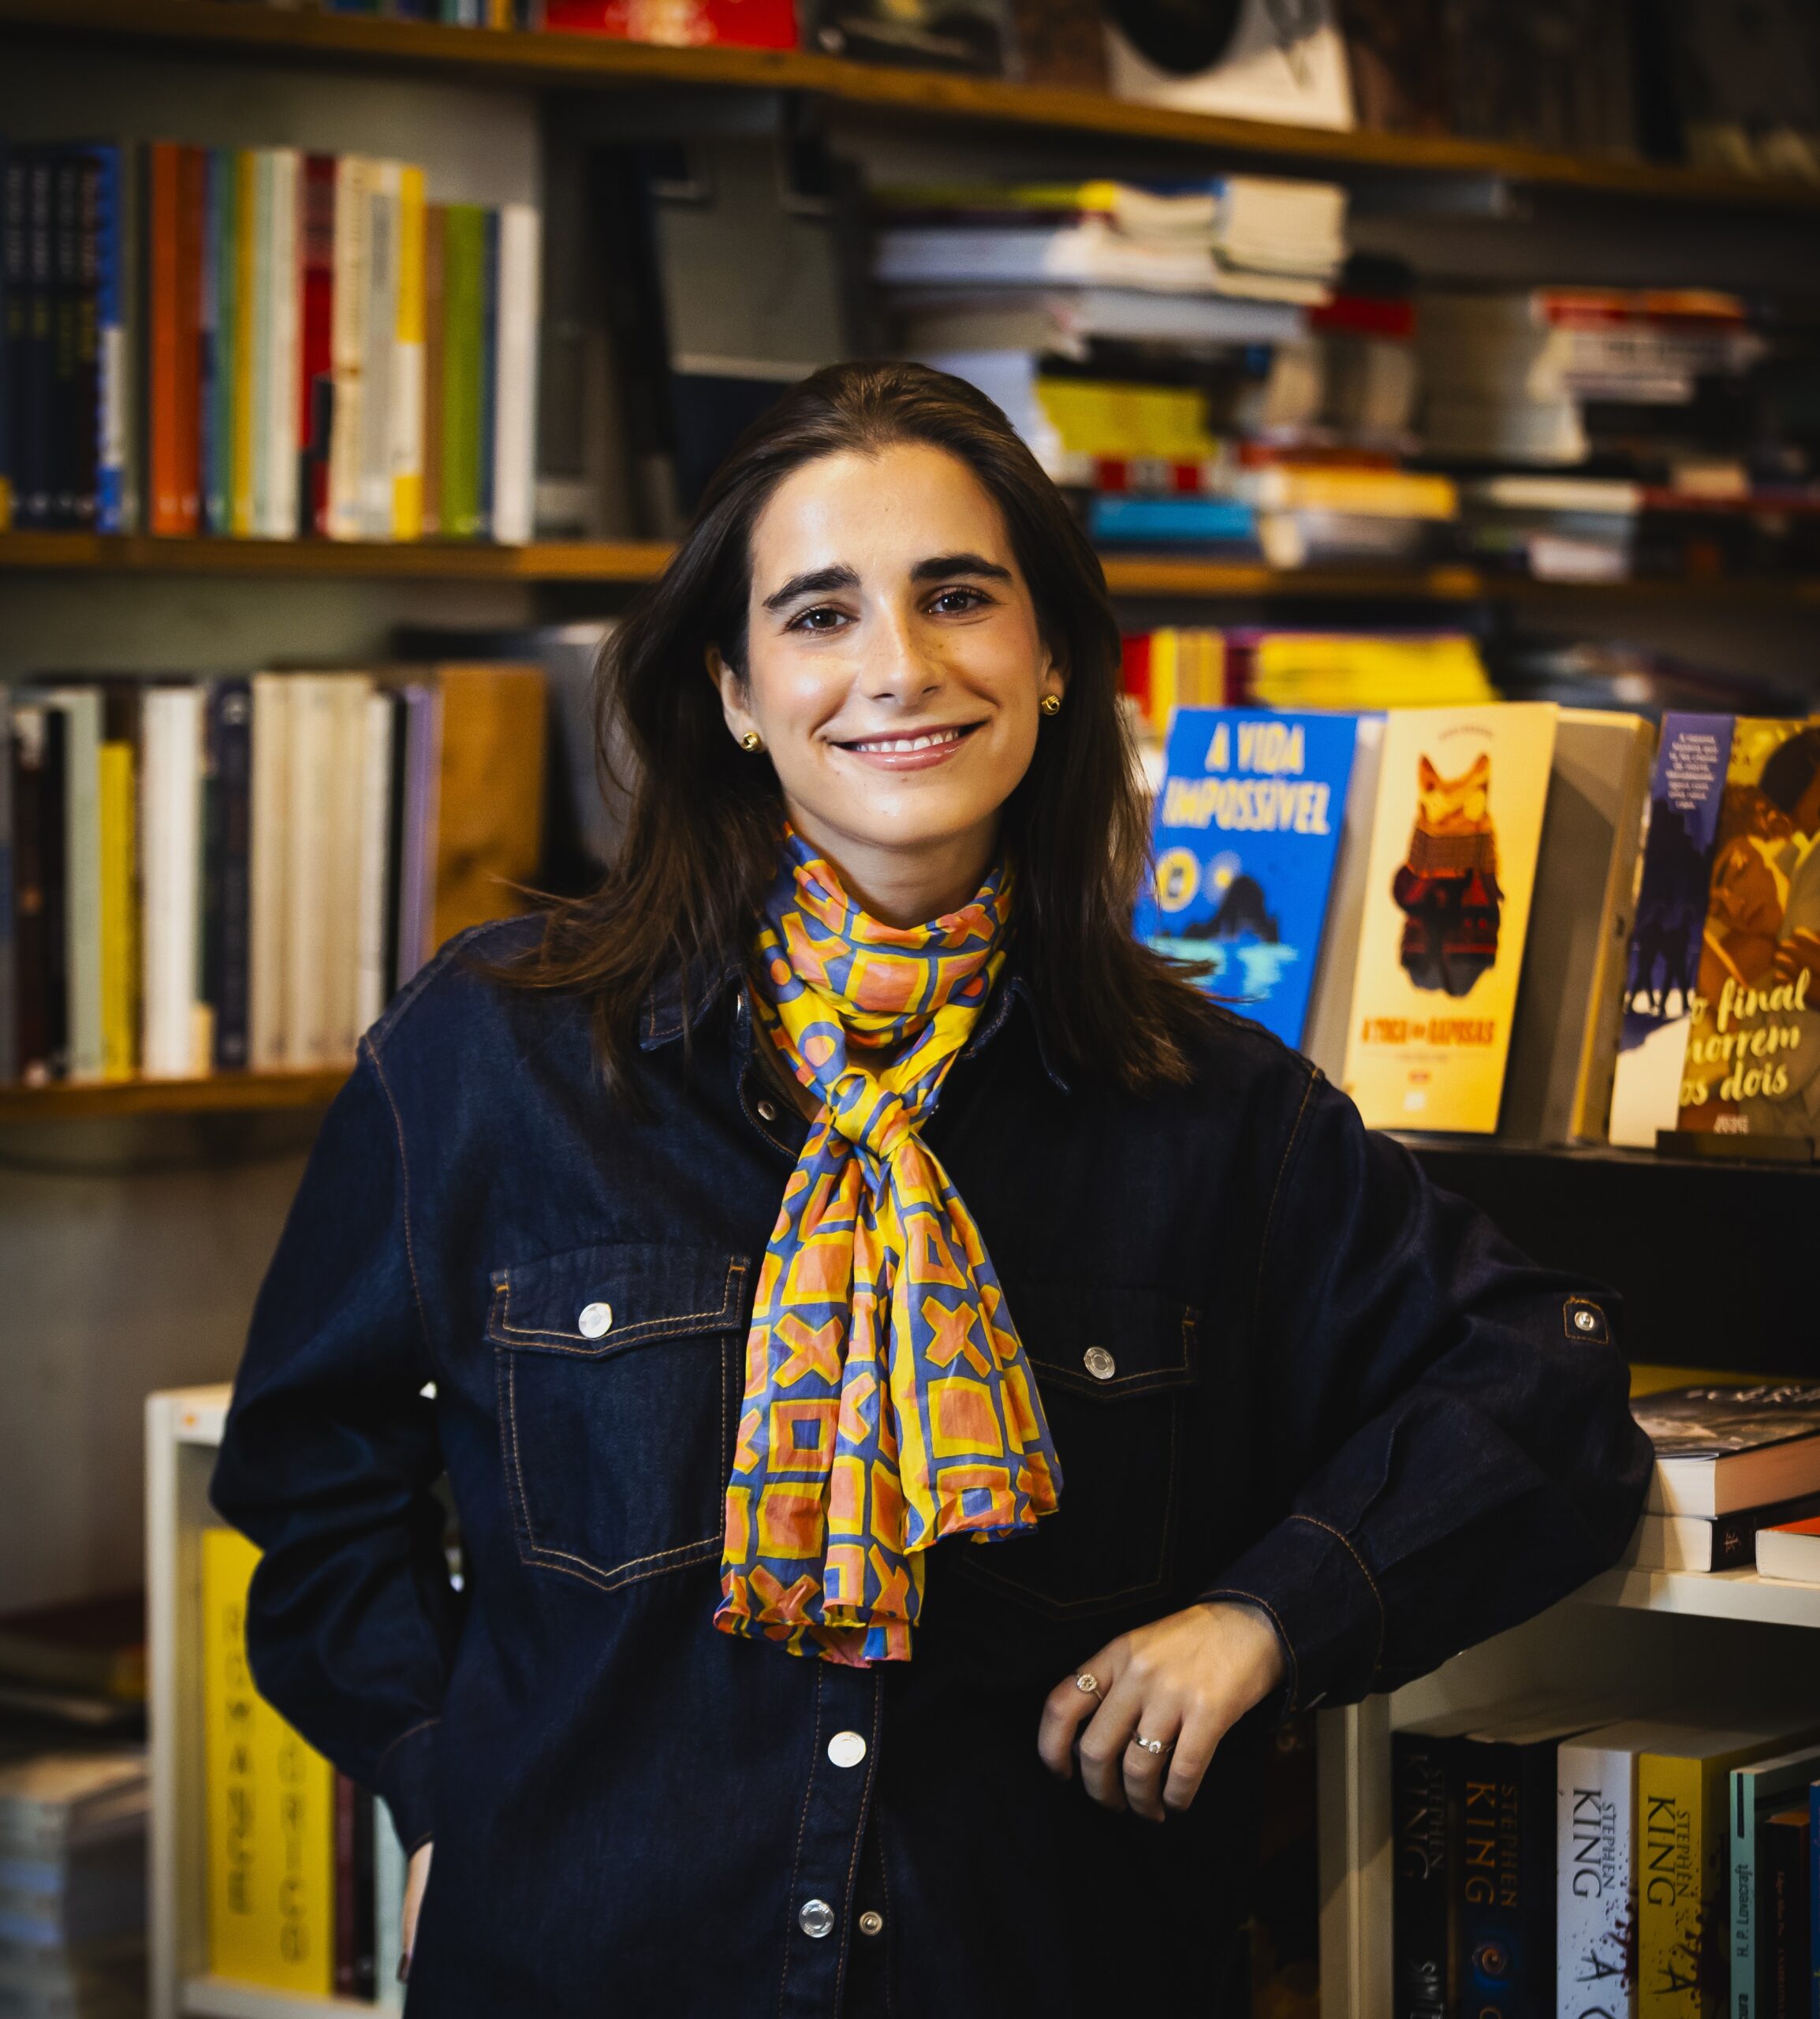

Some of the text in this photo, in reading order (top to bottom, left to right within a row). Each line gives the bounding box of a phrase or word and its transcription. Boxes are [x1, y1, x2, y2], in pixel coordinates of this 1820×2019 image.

[1204, 721, 1306, 774] A VIDA
[1717, 967, 1811, 1033] final
[1719, 1058, 1788, 1102] dois
[1400, 1753, 1429, 1880] KING
[1428, 1767, 1445, 1869] STEPHEN
[1464, 1780, 1496, 1905] KING
[1501, 1784, 1519, 1907] STEPHEN
[1572, 1788, 1602, 1899] KING
[1602, 1801, 1615, 1890] STEPHEN
[1647, 1794, 1676, 1908] KING
[1676, 1809, 1691, 1898] STEPHEN
[1735, 1863, 1753, 1957] H. P. Lovecraft
